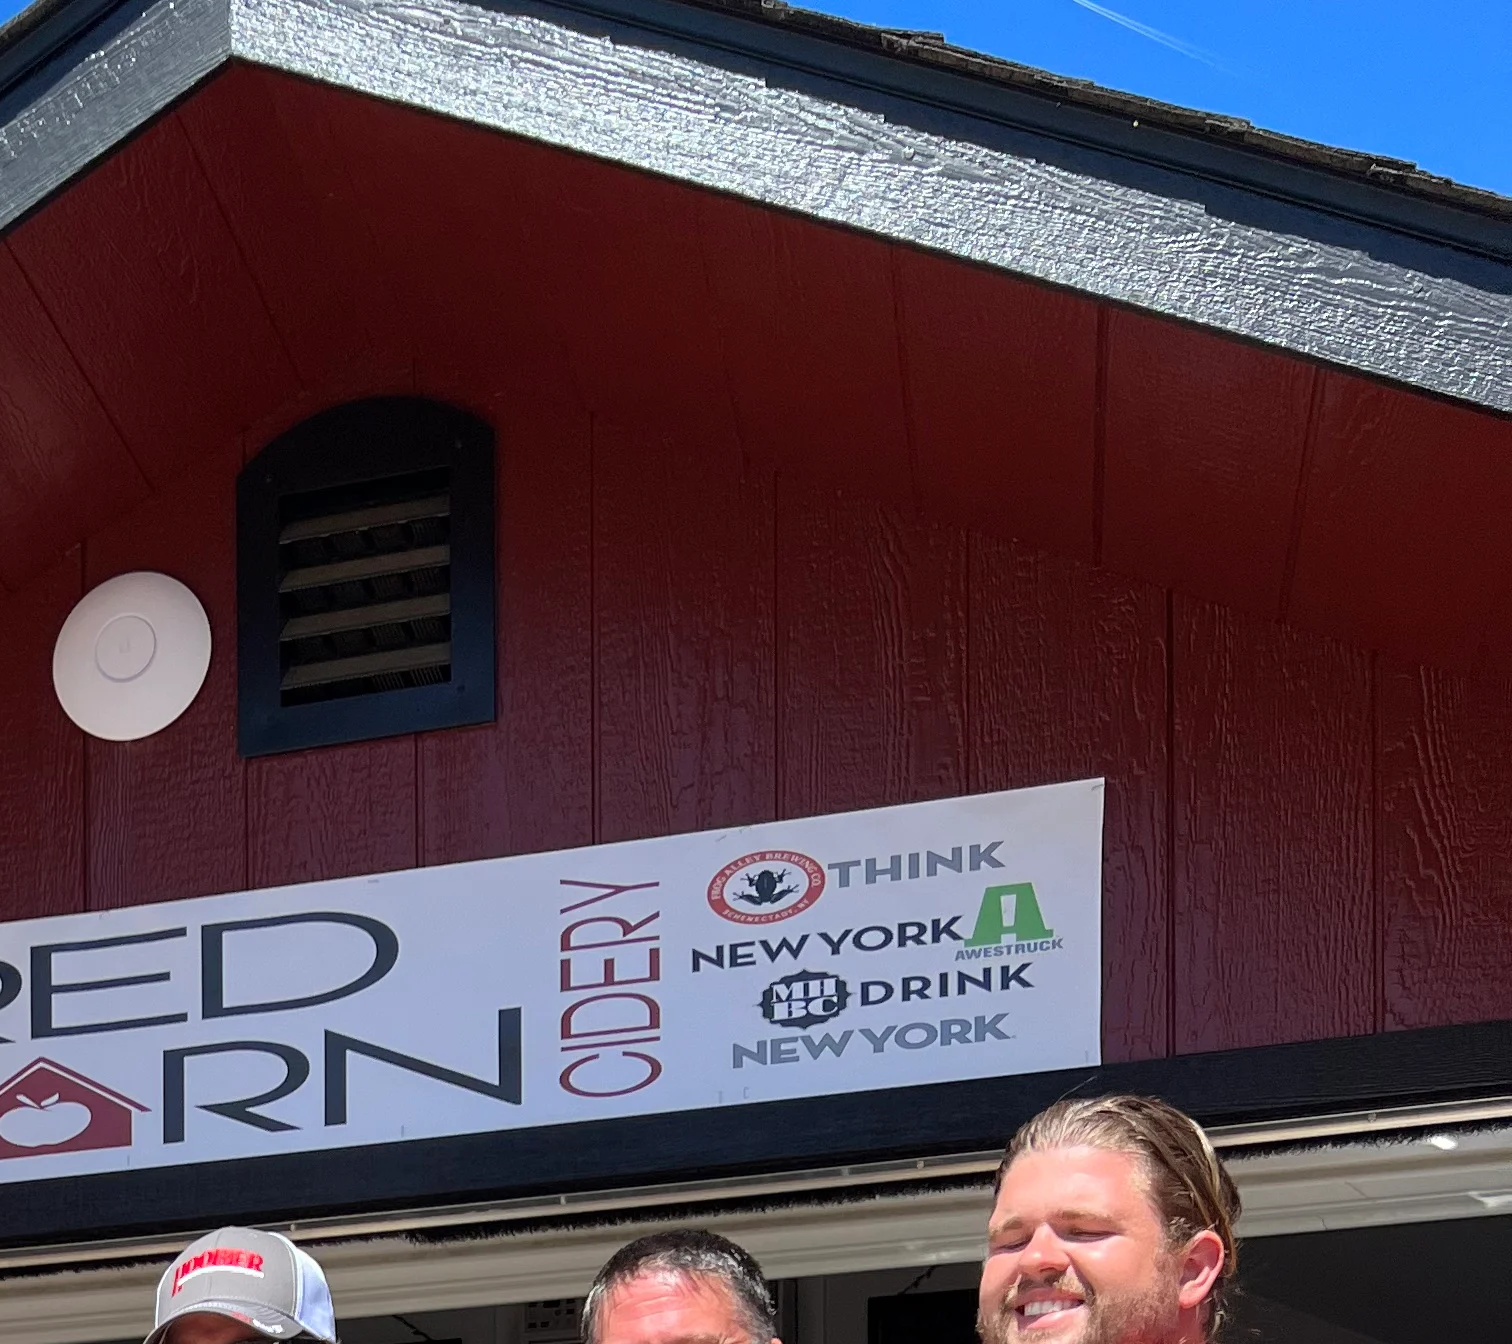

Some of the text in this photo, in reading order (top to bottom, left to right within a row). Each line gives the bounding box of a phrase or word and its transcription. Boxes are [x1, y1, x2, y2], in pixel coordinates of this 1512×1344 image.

[725, 854, 762, 875] ALLEY
[765, 852, 818, 874] BREWING
[828, 841, 1006, 888] THINK
[692, 915, 964, 972] NEW YORK
[955, 937, 1064, 961] AWESTRUCK
[559, 878, 662, 1098] CIDERY
[860, 962, 1035, 1007] DRINK
[732, 1030, 854, 1068] NEW
